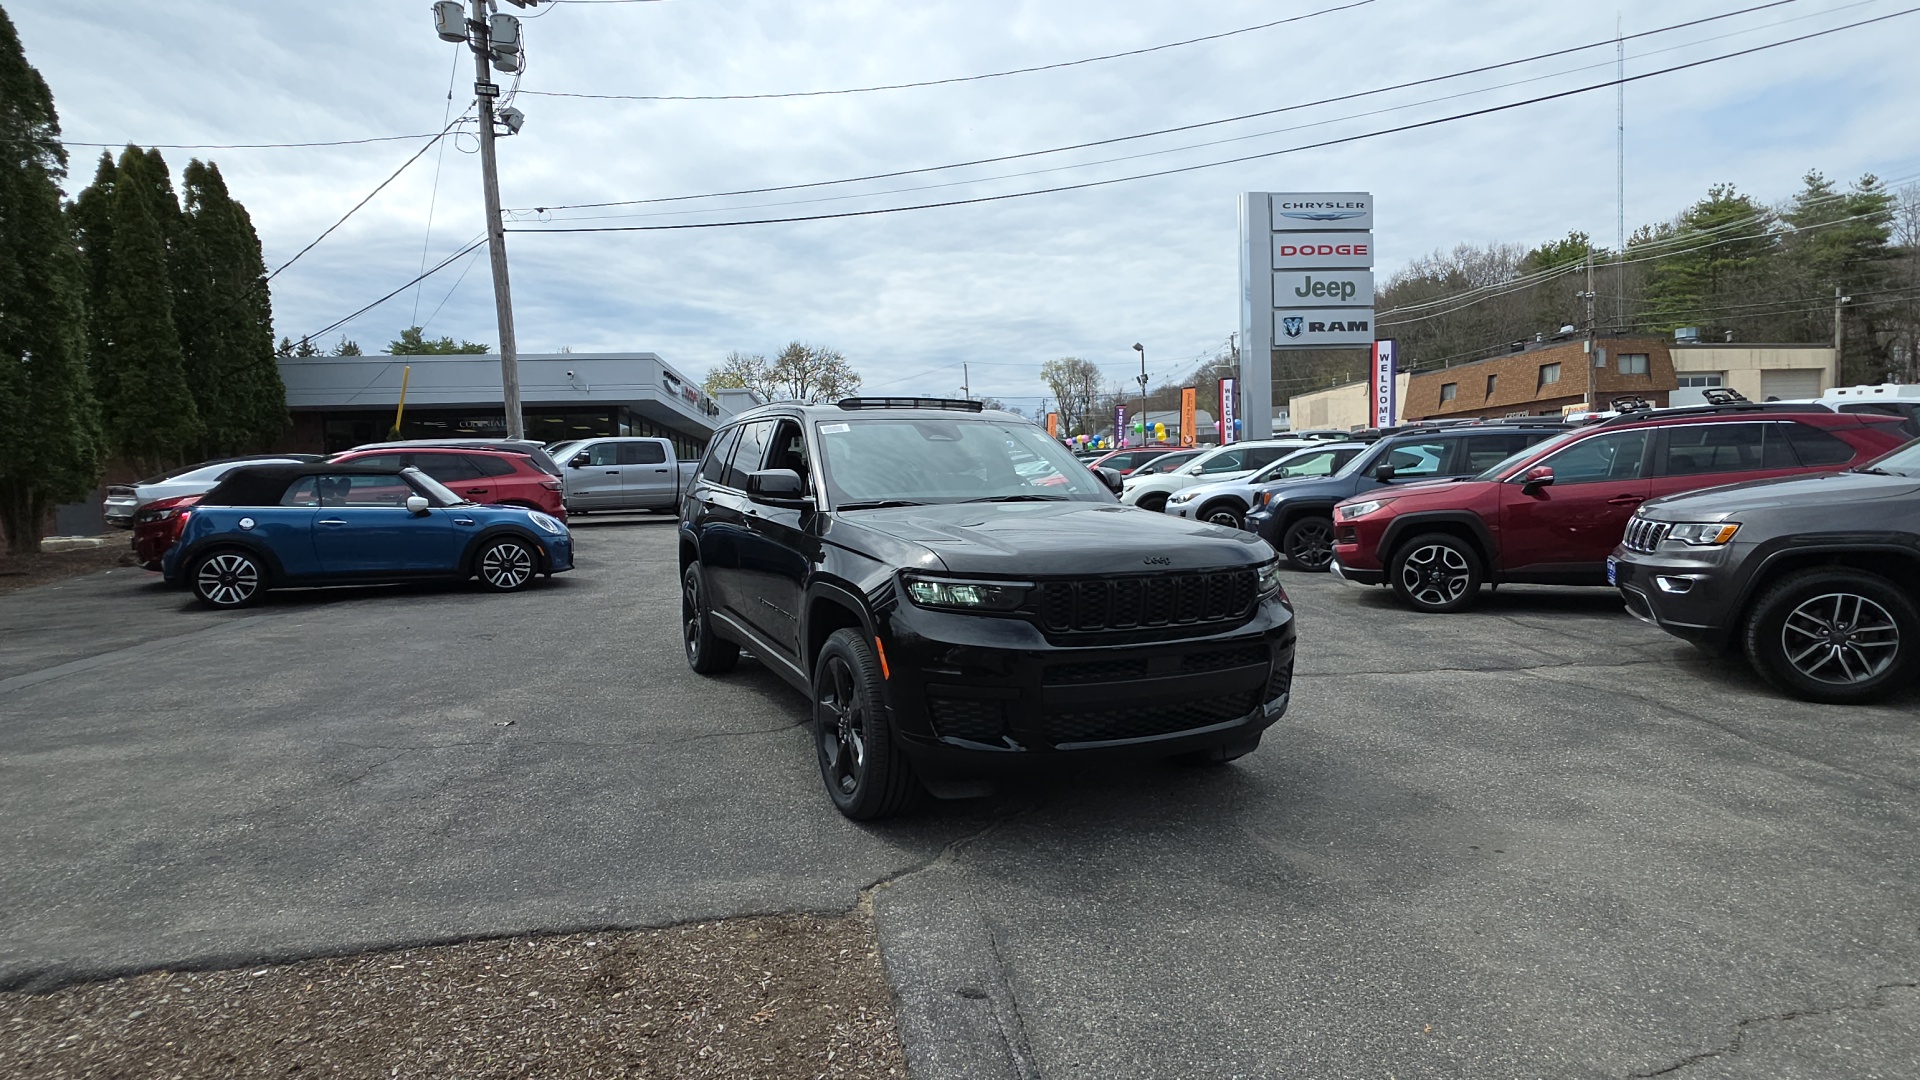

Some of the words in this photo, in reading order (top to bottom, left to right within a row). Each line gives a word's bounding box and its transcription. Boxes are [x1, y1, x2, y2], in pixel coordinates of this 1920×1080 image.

[1280, 245, 1367, 256] DODGE
[1294, 275, 1356, 301] Jeep
[1308, 321, 1368, 332] RAM
[1379, 353, 1389, 423] WELCOME
[1224, 388, 1232, 439] WELCOME
[1143, 556, 1171, 566] Jeep
